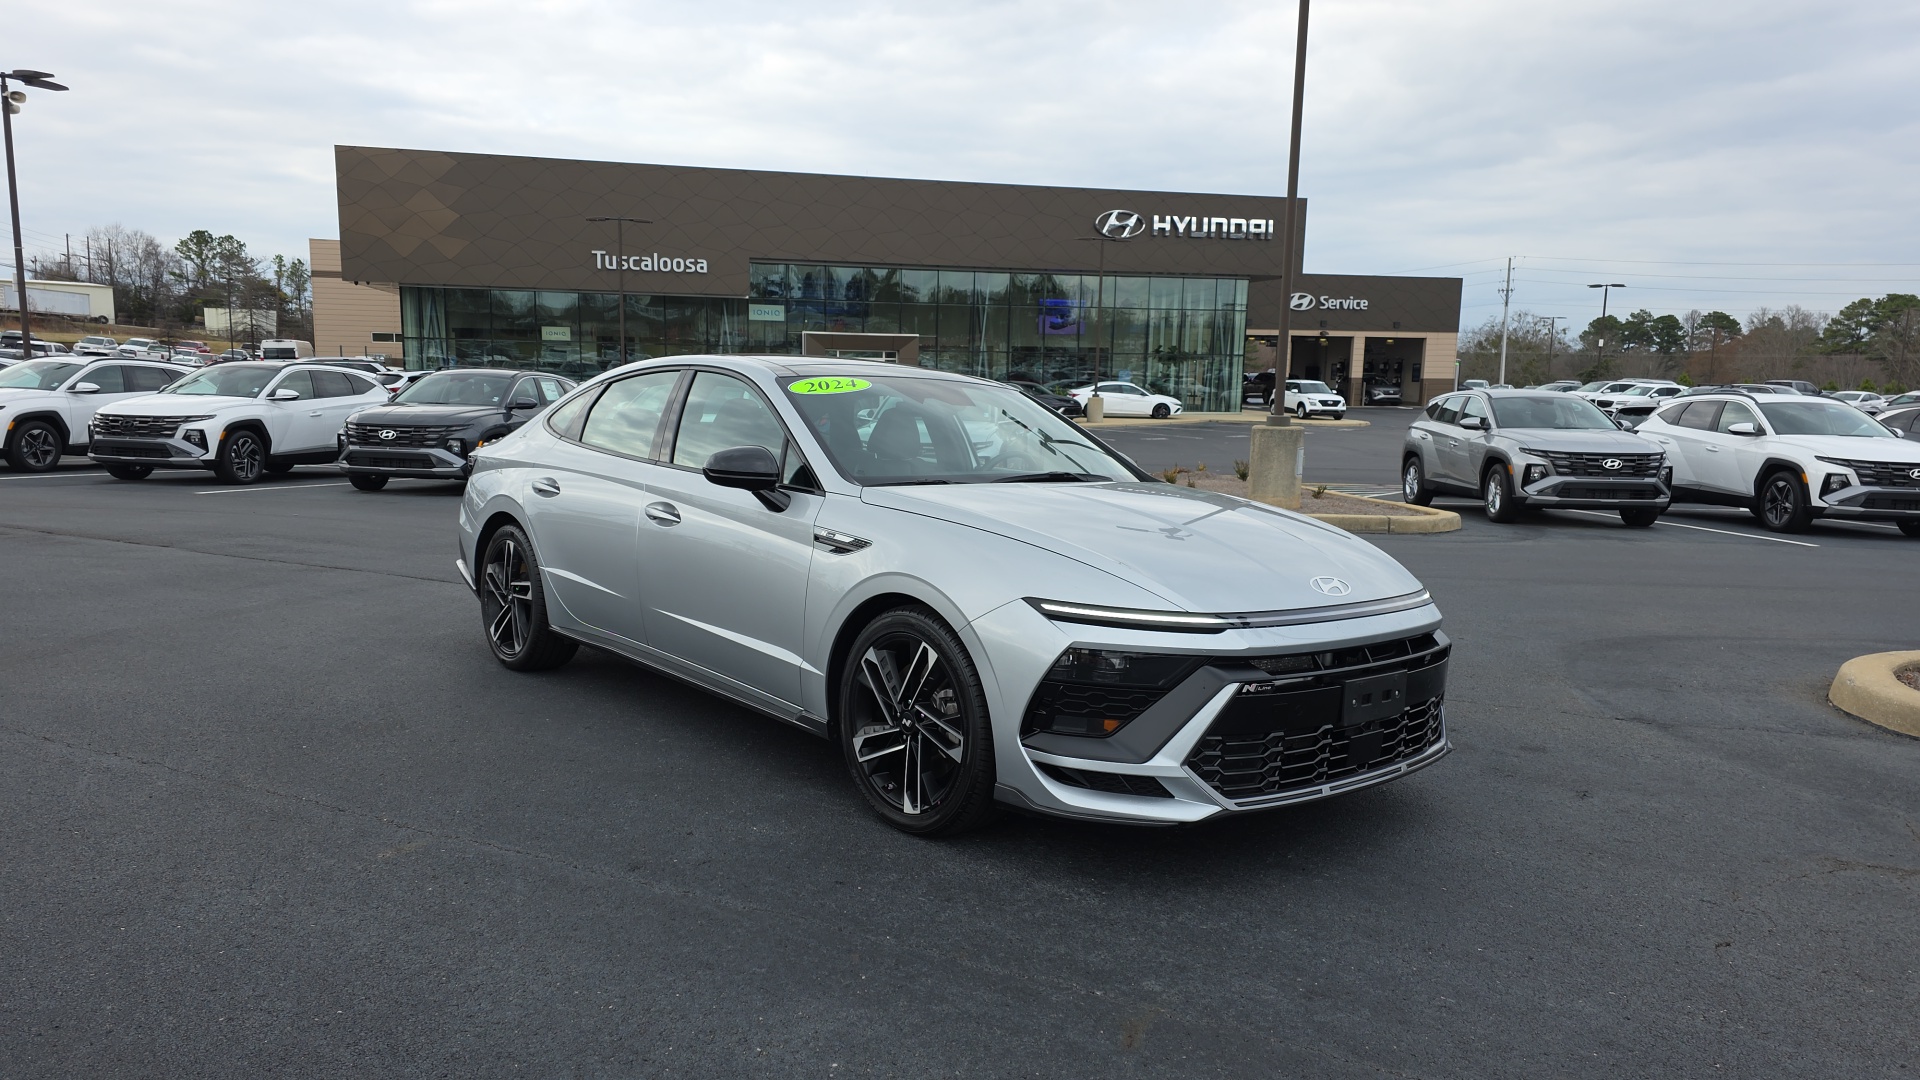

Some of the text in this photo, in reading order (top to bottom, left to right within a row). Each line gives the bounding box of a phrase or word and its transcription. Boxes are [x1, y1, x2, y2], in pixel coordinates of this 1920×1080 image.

[1153, 214, 1274, 240] HYUNDAI
[591, 250, 708, 273] Tuscaloosa
[1319, 296, 1368, 310] Service
[804, 379, 857, 393] 2024
